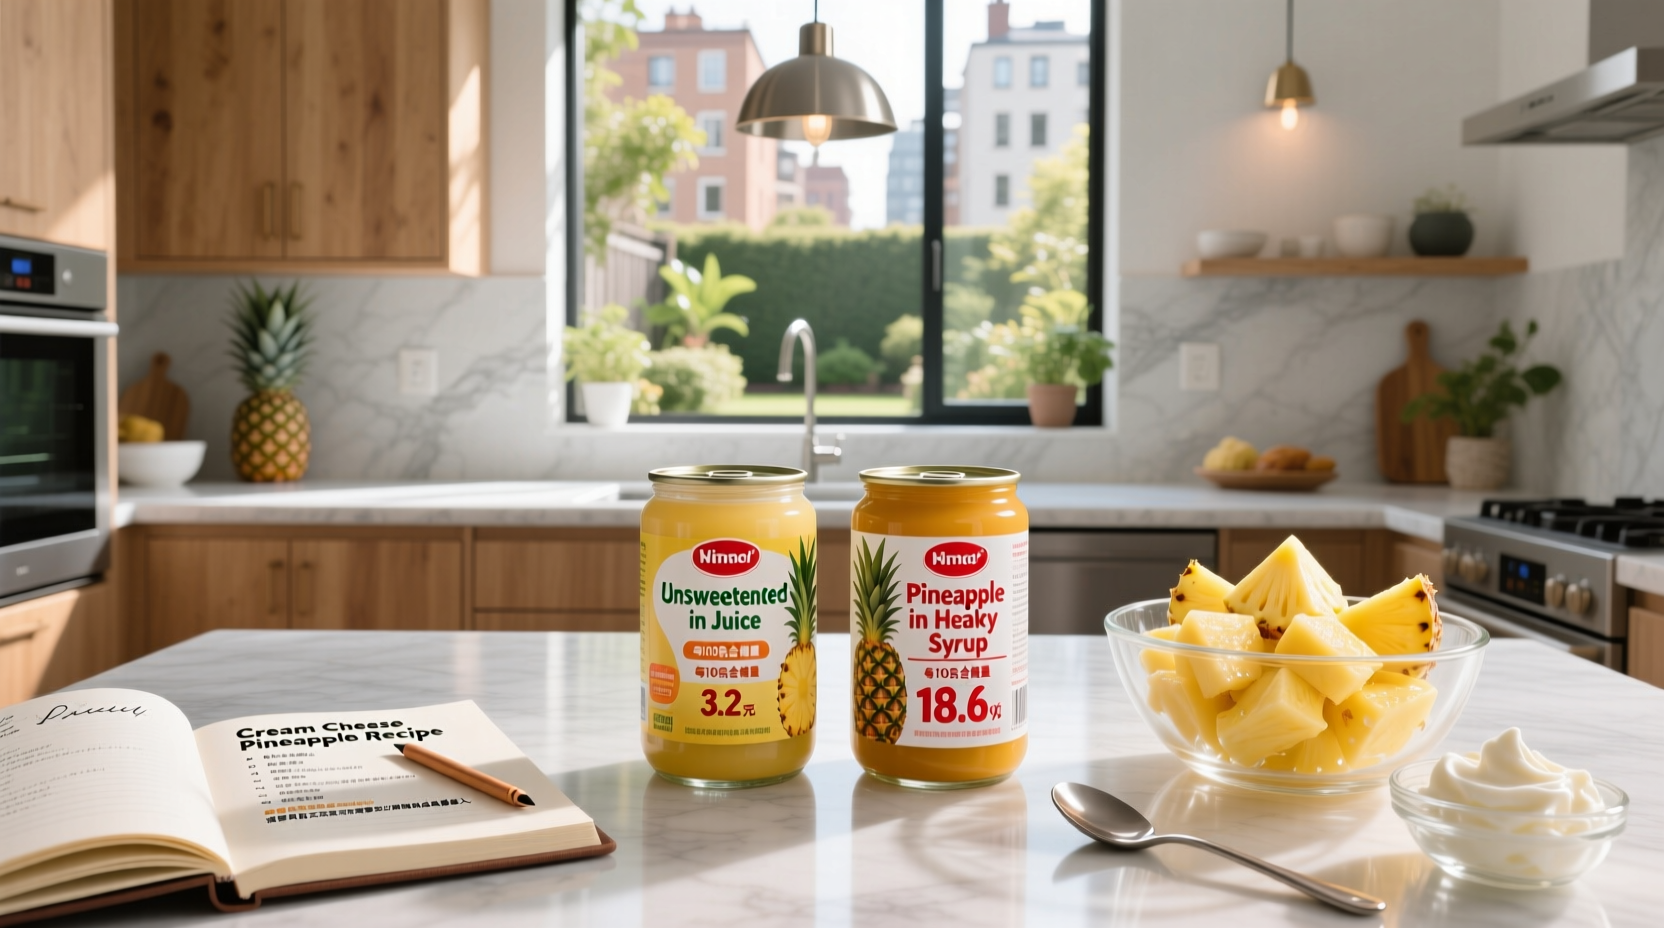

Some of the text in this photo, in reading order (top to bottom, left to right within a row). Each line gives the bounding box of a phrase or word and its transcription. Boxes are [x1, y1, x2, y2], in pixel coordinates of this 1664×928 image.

[906, 580, 1005, 610] Pineapple
[689, 609, 762, 630] in Juice
[909, 608, 998, 634] in Heaky
[928, 632, 988, 659] Syrup
[236, 726, 316, 739] Cream
[365, 727, 444, 742] Recipe
